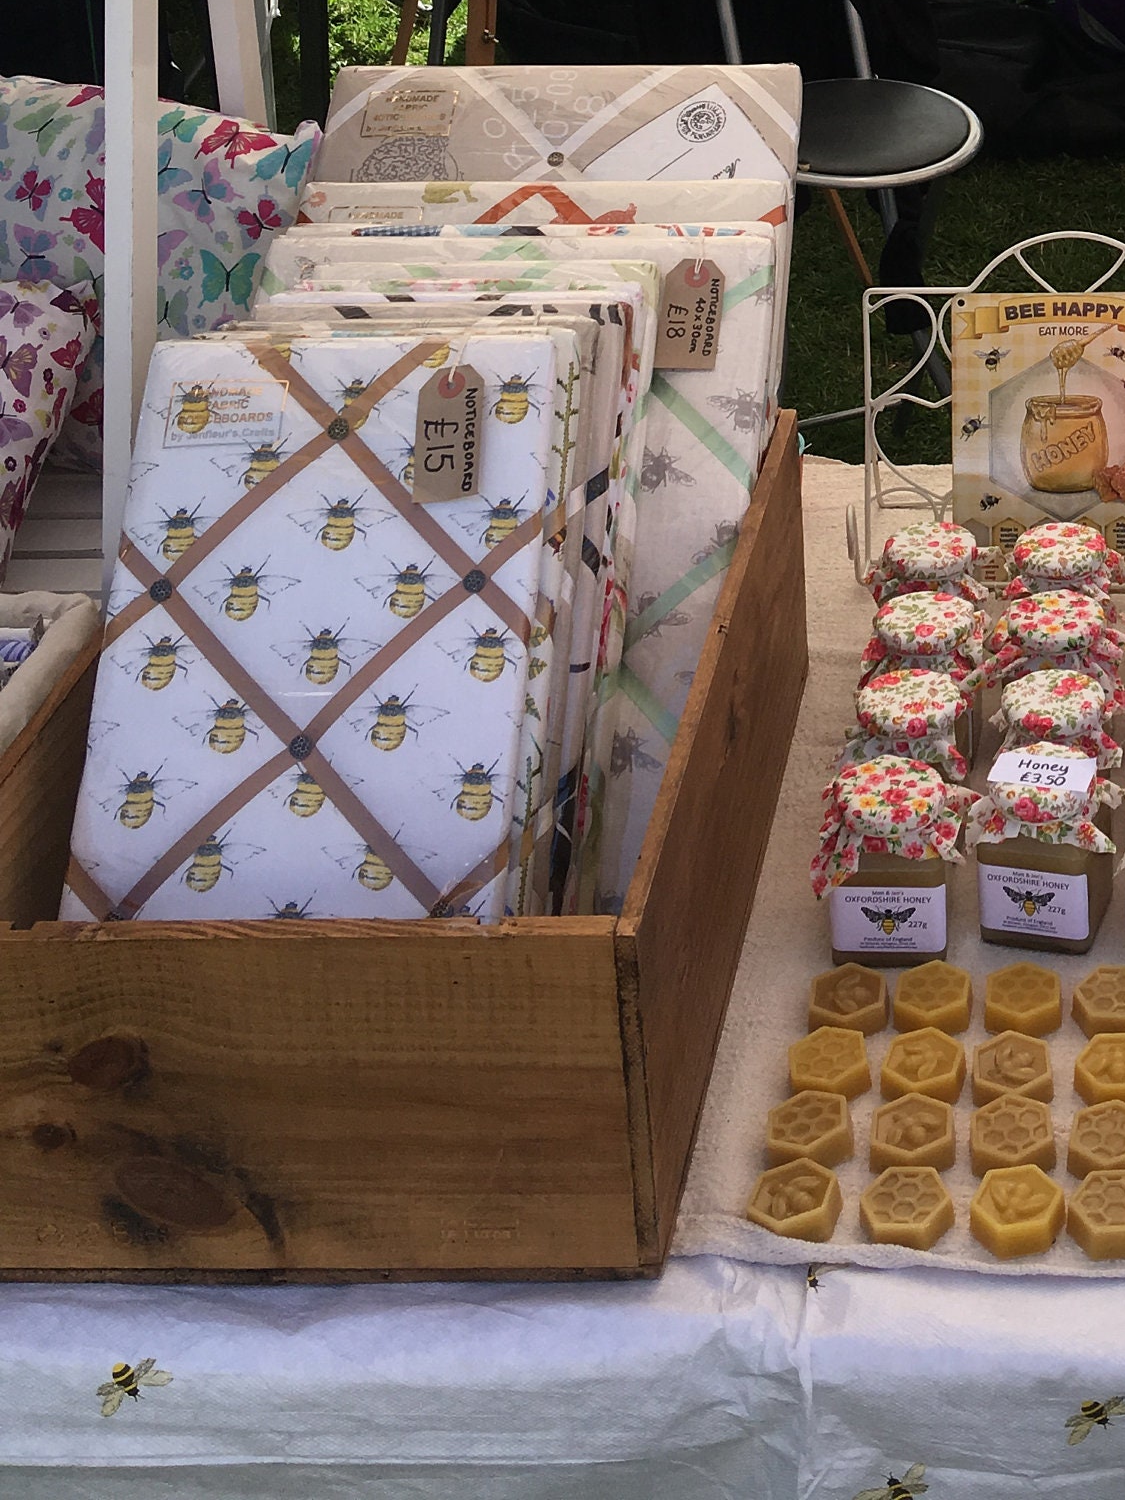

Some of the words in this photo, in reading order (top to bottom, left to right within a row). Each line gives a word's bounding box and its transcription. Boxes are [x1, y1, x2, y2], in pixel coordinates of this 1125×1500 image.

[702, 278, 720, 356] NOTICEBOARD
[1004, 302, 1046, 320] BEE
[1052, 302, 1125, 319] HAPPY
[666, 303, 689, 339] £18
[1039, 327, 1058, 336] EAT
[1059, 326, 1089, 336] MORE
[423, 417, 459, 473] £15
[461, 388, 481, 492] NOTICEBOARD
[1031, 421, 1097, 473] HONEY
[1018, 759, 1069, 776] Honey
[1020, 772, 1067, 786] £3.50
[987, 873, 1041, 887] OXFORDSHIRE
[1042, 880, 1070, 891] HONEY
[1048, 906, 1066, 916] 227g
[908, 921, 927, 929] 227g
